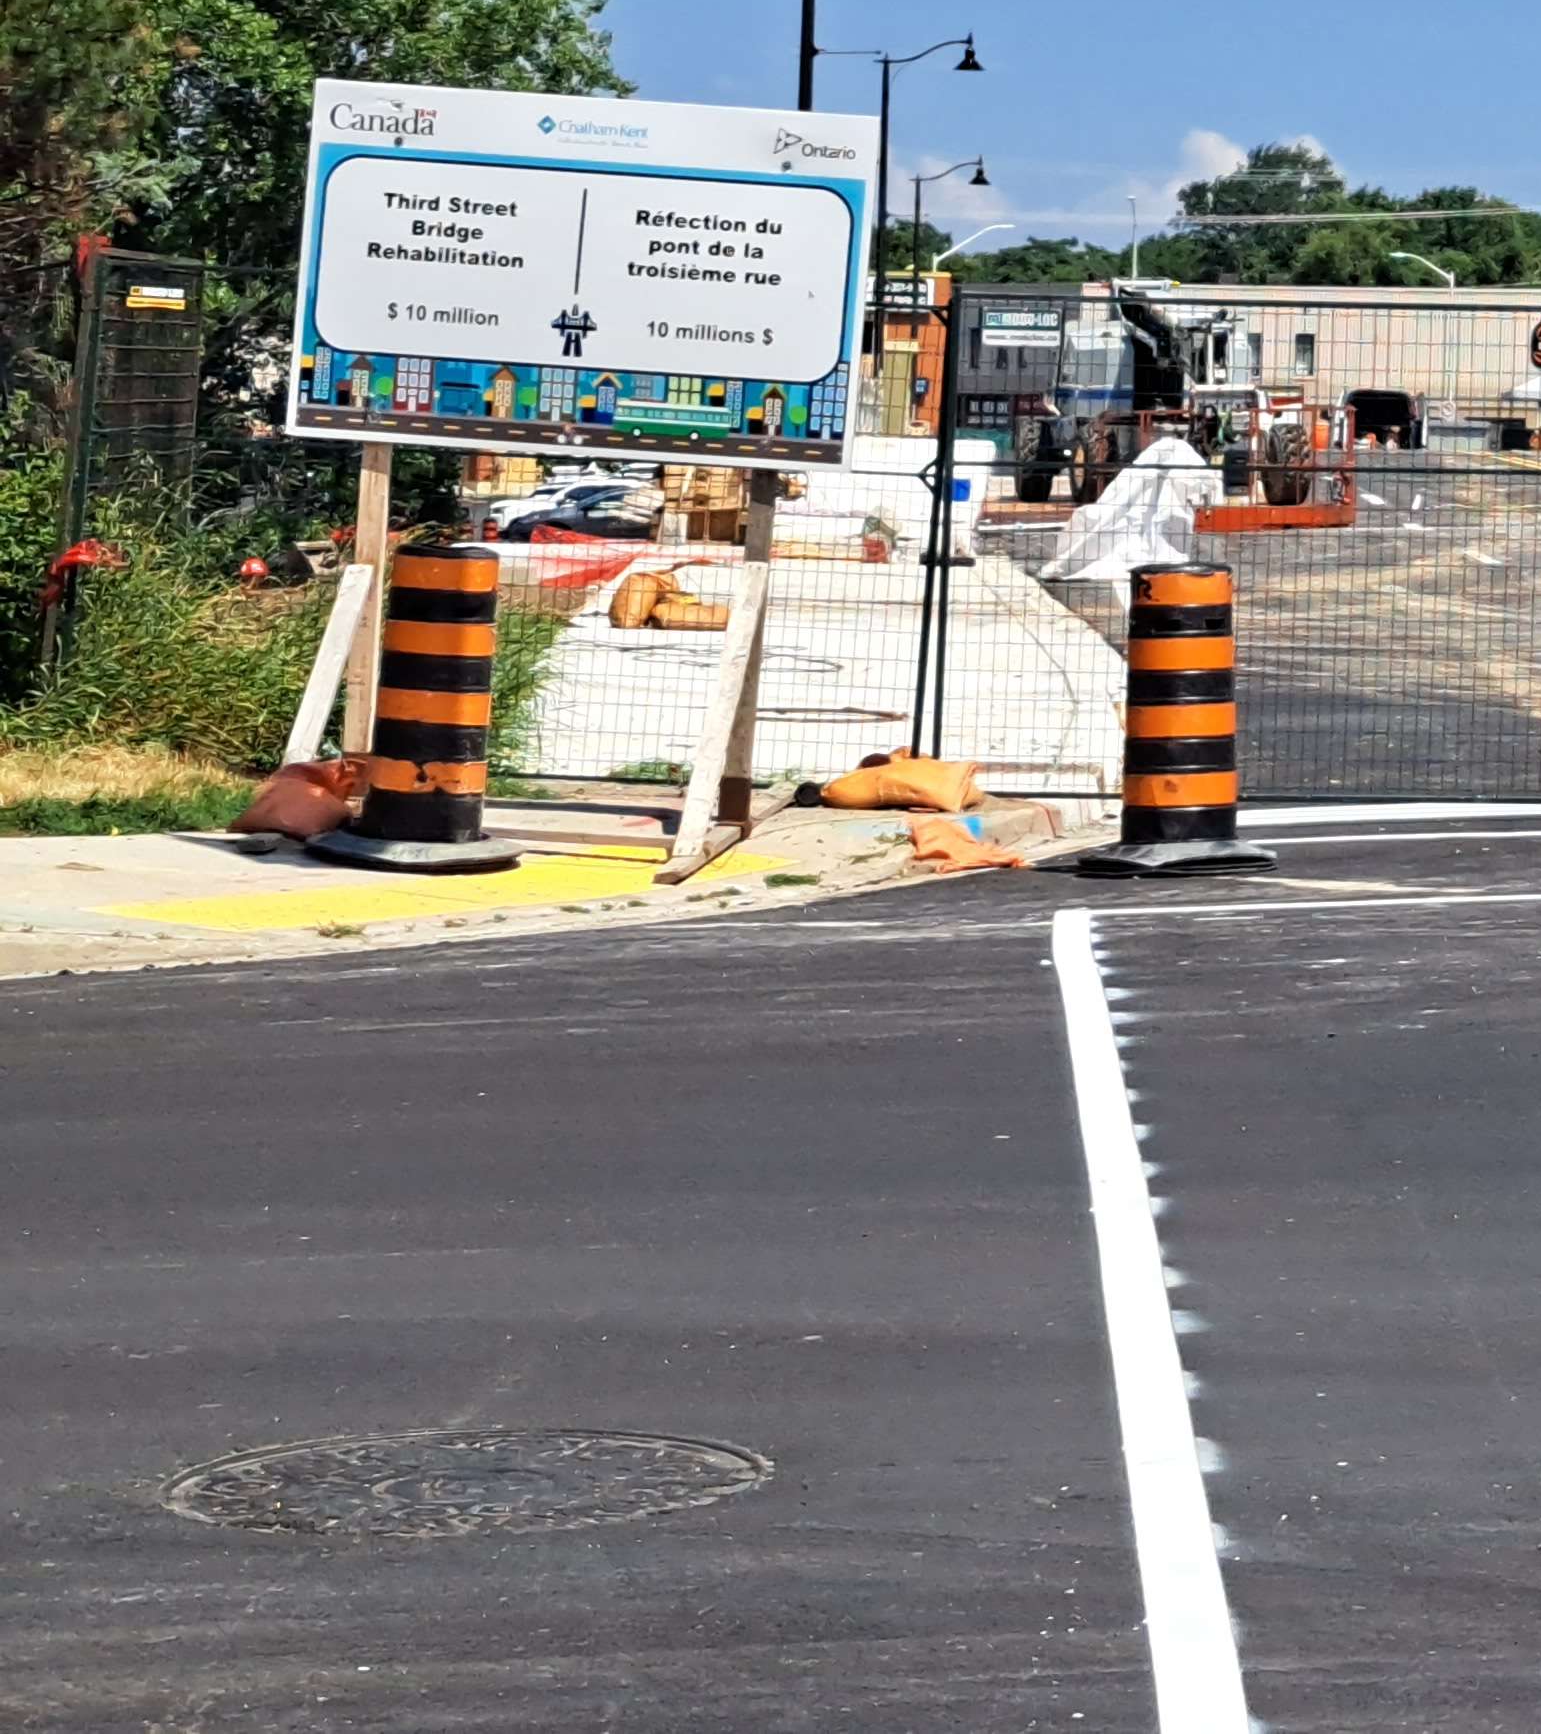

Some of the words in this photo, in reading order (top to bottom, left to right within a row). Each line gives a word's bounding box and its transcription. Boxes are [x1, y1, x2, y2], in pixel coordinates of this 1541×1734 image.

[328, 102, 435, 136] Canada
[801, 142, 856, 160] Ontario
[384, 192, 441, 212] Third
[448, 196, 518, 217] Street
[411, 219, 484, 243] Bridge
[635, 209, 747, 232] Réfection
[755, 218, 783, 235] du
[367, 241, 524, 268] Rehabilitation
[648, 240, 700, 256] pont
[707, 240, 736, 257] de
[743, 243, 764, 259] la
[627, 261, 737, 282] troisième
[744, 271, 782, 286] rue
[387, 301, 399, 321] $
[405, 303, 427, 321] 10
[432, 306, 500, 326] million
[646, 320, 669, 338] 10
[675, 324, 756, 344] millions
[762, 327, 774, 346] $
